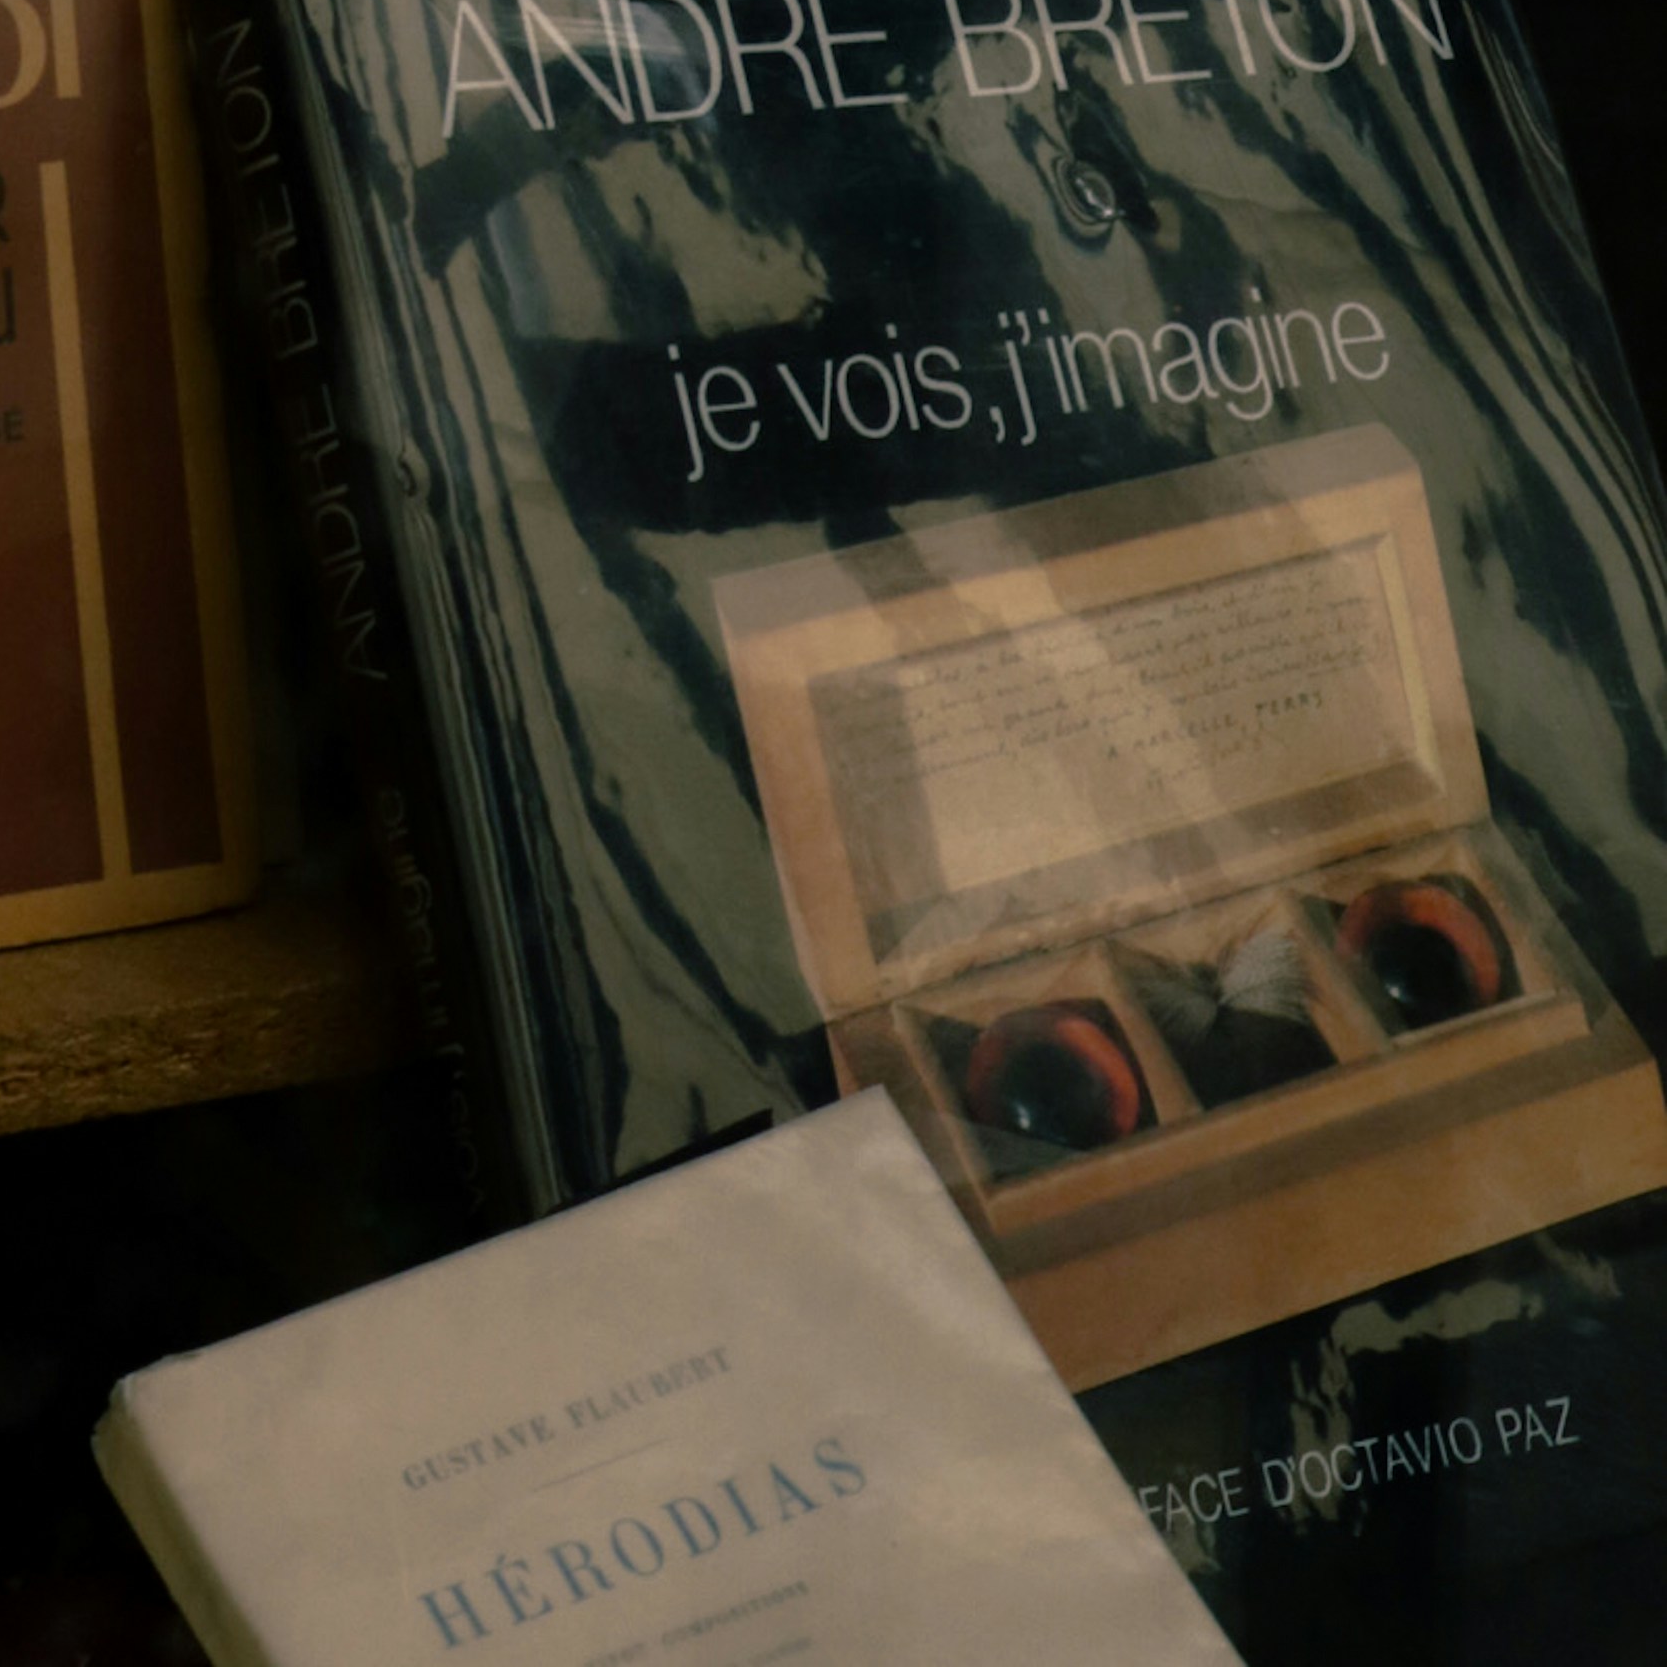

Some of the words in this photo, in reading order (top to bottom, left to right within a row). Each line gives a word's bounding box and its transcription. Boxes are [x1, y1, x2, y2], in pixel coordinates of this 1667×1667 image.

[668, 344, 762, 483] je
[399, 1413, 557, 1493] GUSTAVE
[563, 1343, 735, 1432] FLAUBERT
[1261, 1416, 1485, 1509] D'OCTAVIO
[1495, 1396, 1581, 1457] PAZ
[416, 1434, 872, 1653] HÉRODIAS
